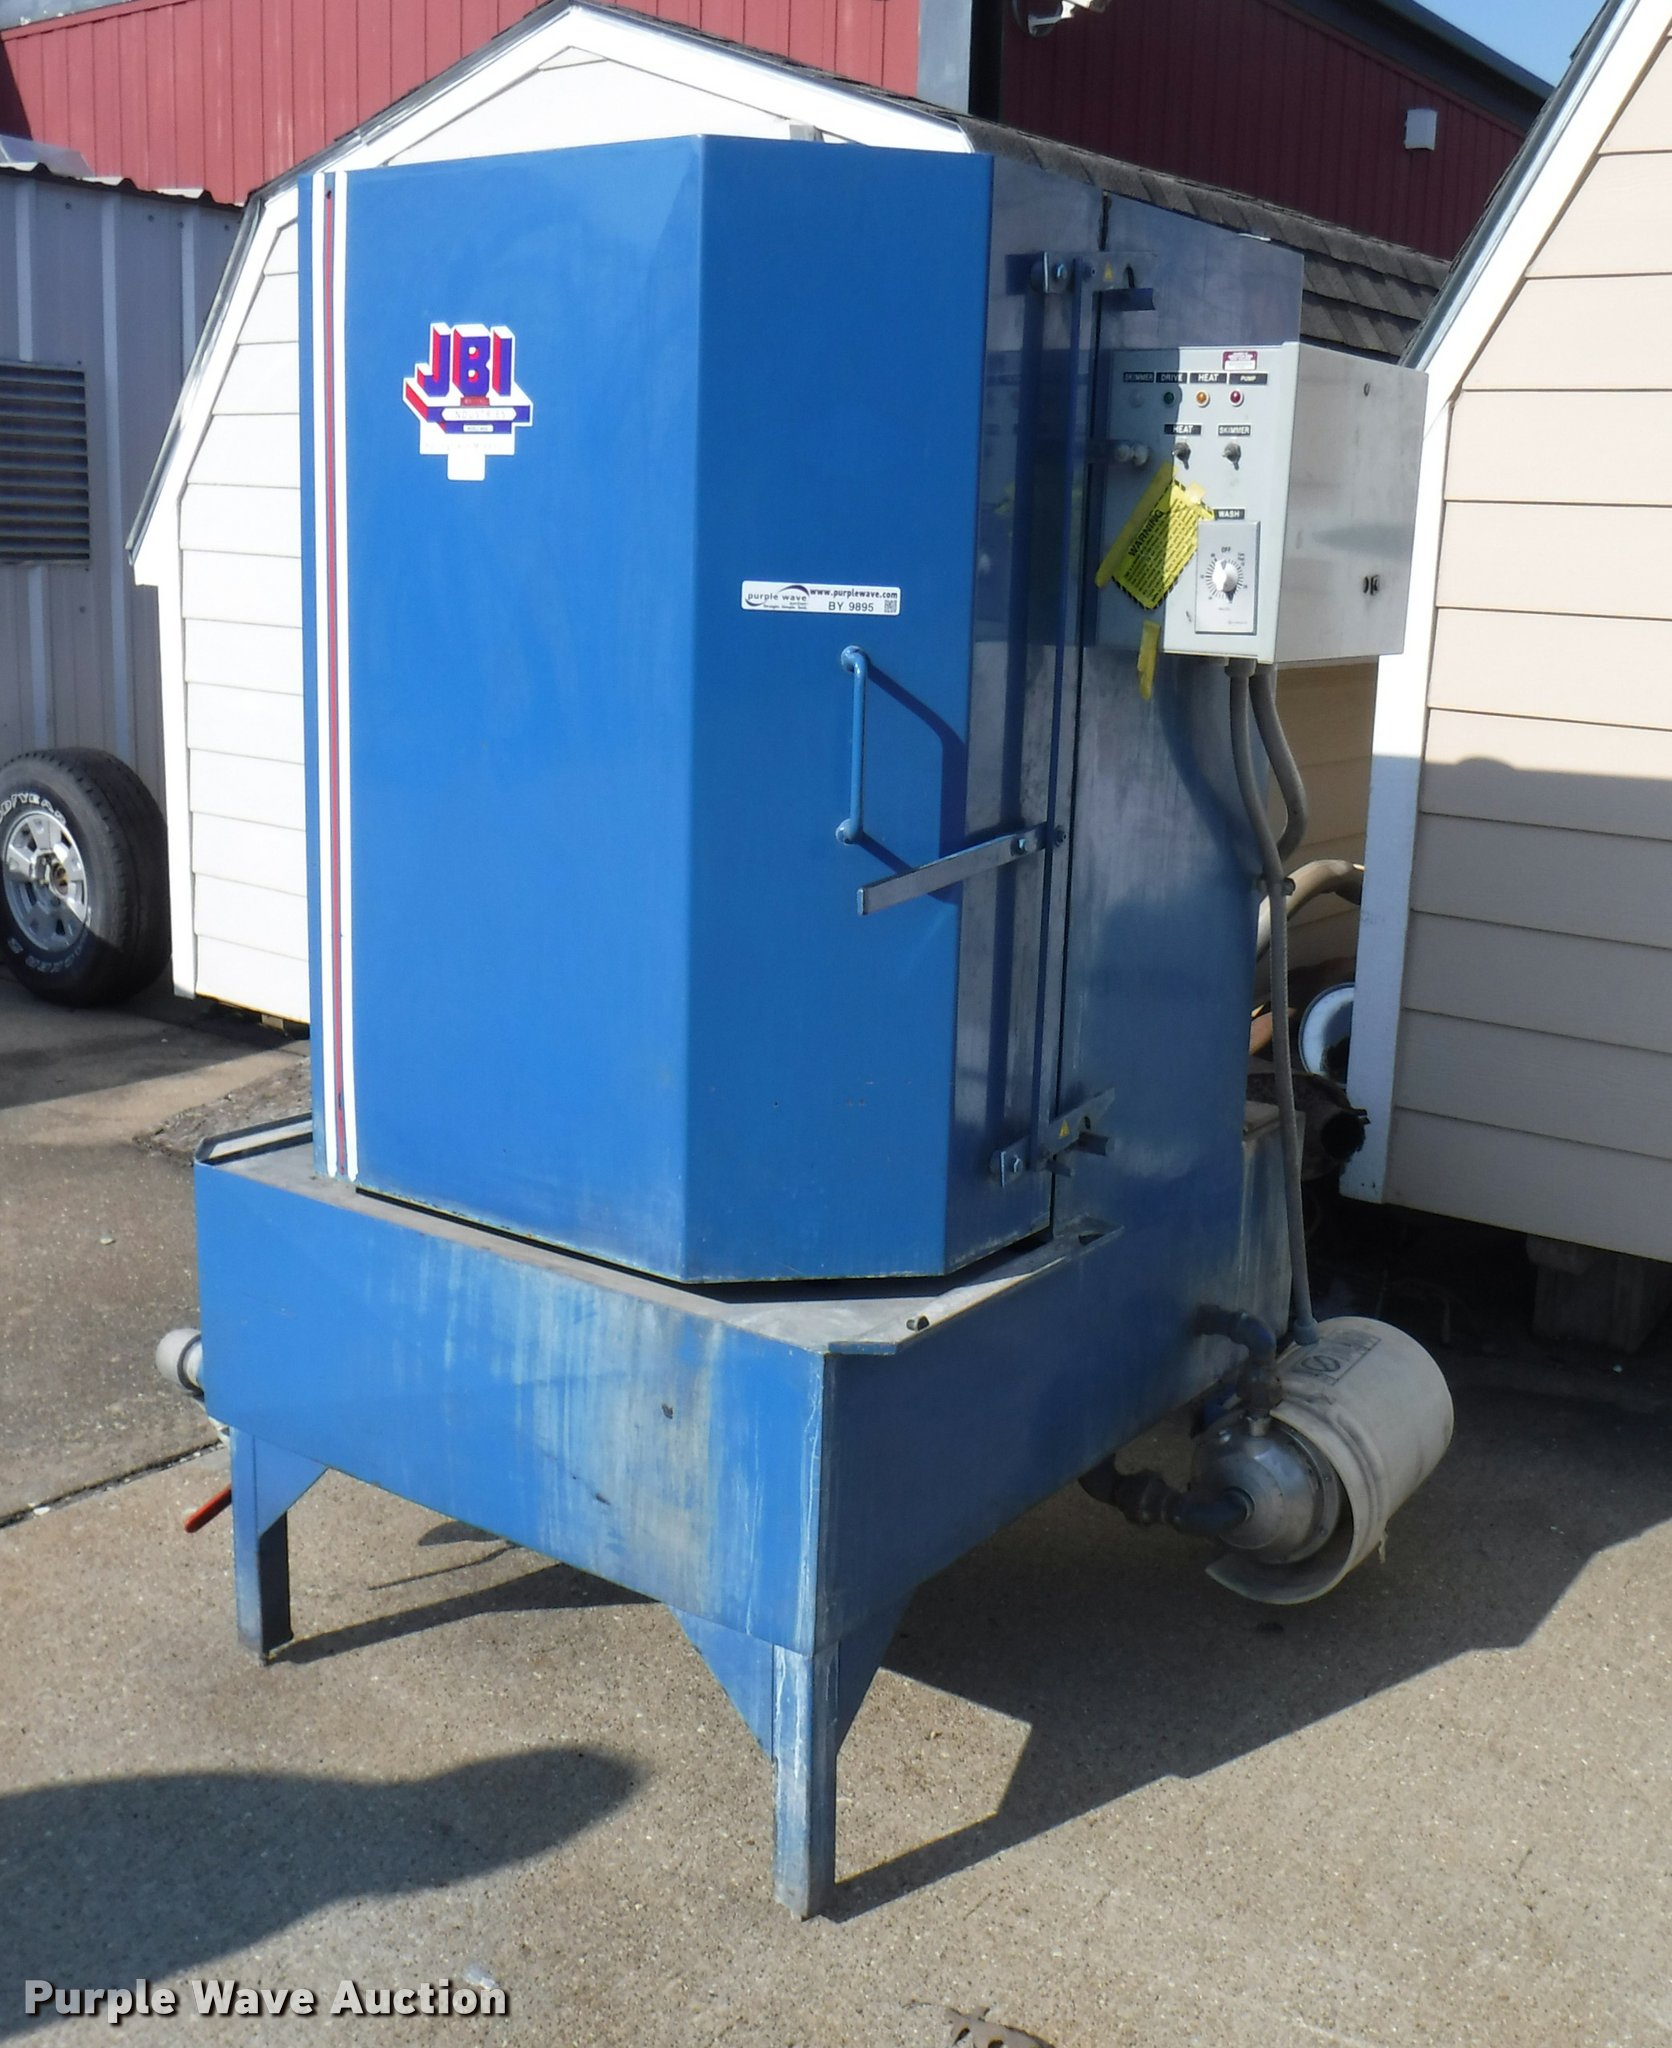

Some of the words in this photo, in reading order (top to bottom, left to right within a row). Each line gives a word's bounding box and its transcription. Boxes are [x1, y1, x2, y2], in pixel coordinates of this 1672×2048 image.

[417, 327, 513, 397] JBI
[1161, 373, 1183, 382] DRIVE
[1198, 374, 1219, 382] HEAT
[1173, 425, 1194, 433] HEAT
[1219, 426, 1250, 434] SKIMMER
[1128, 509, 1164, 557] WARNING
[748, 592, 778, 602] purple
[782, 595, 807, 603] wave
[810, 588, 898, 599] www.purplewave.com
[828, 601, 844, 611] BY
[849, 601, 874, 612] 9895
